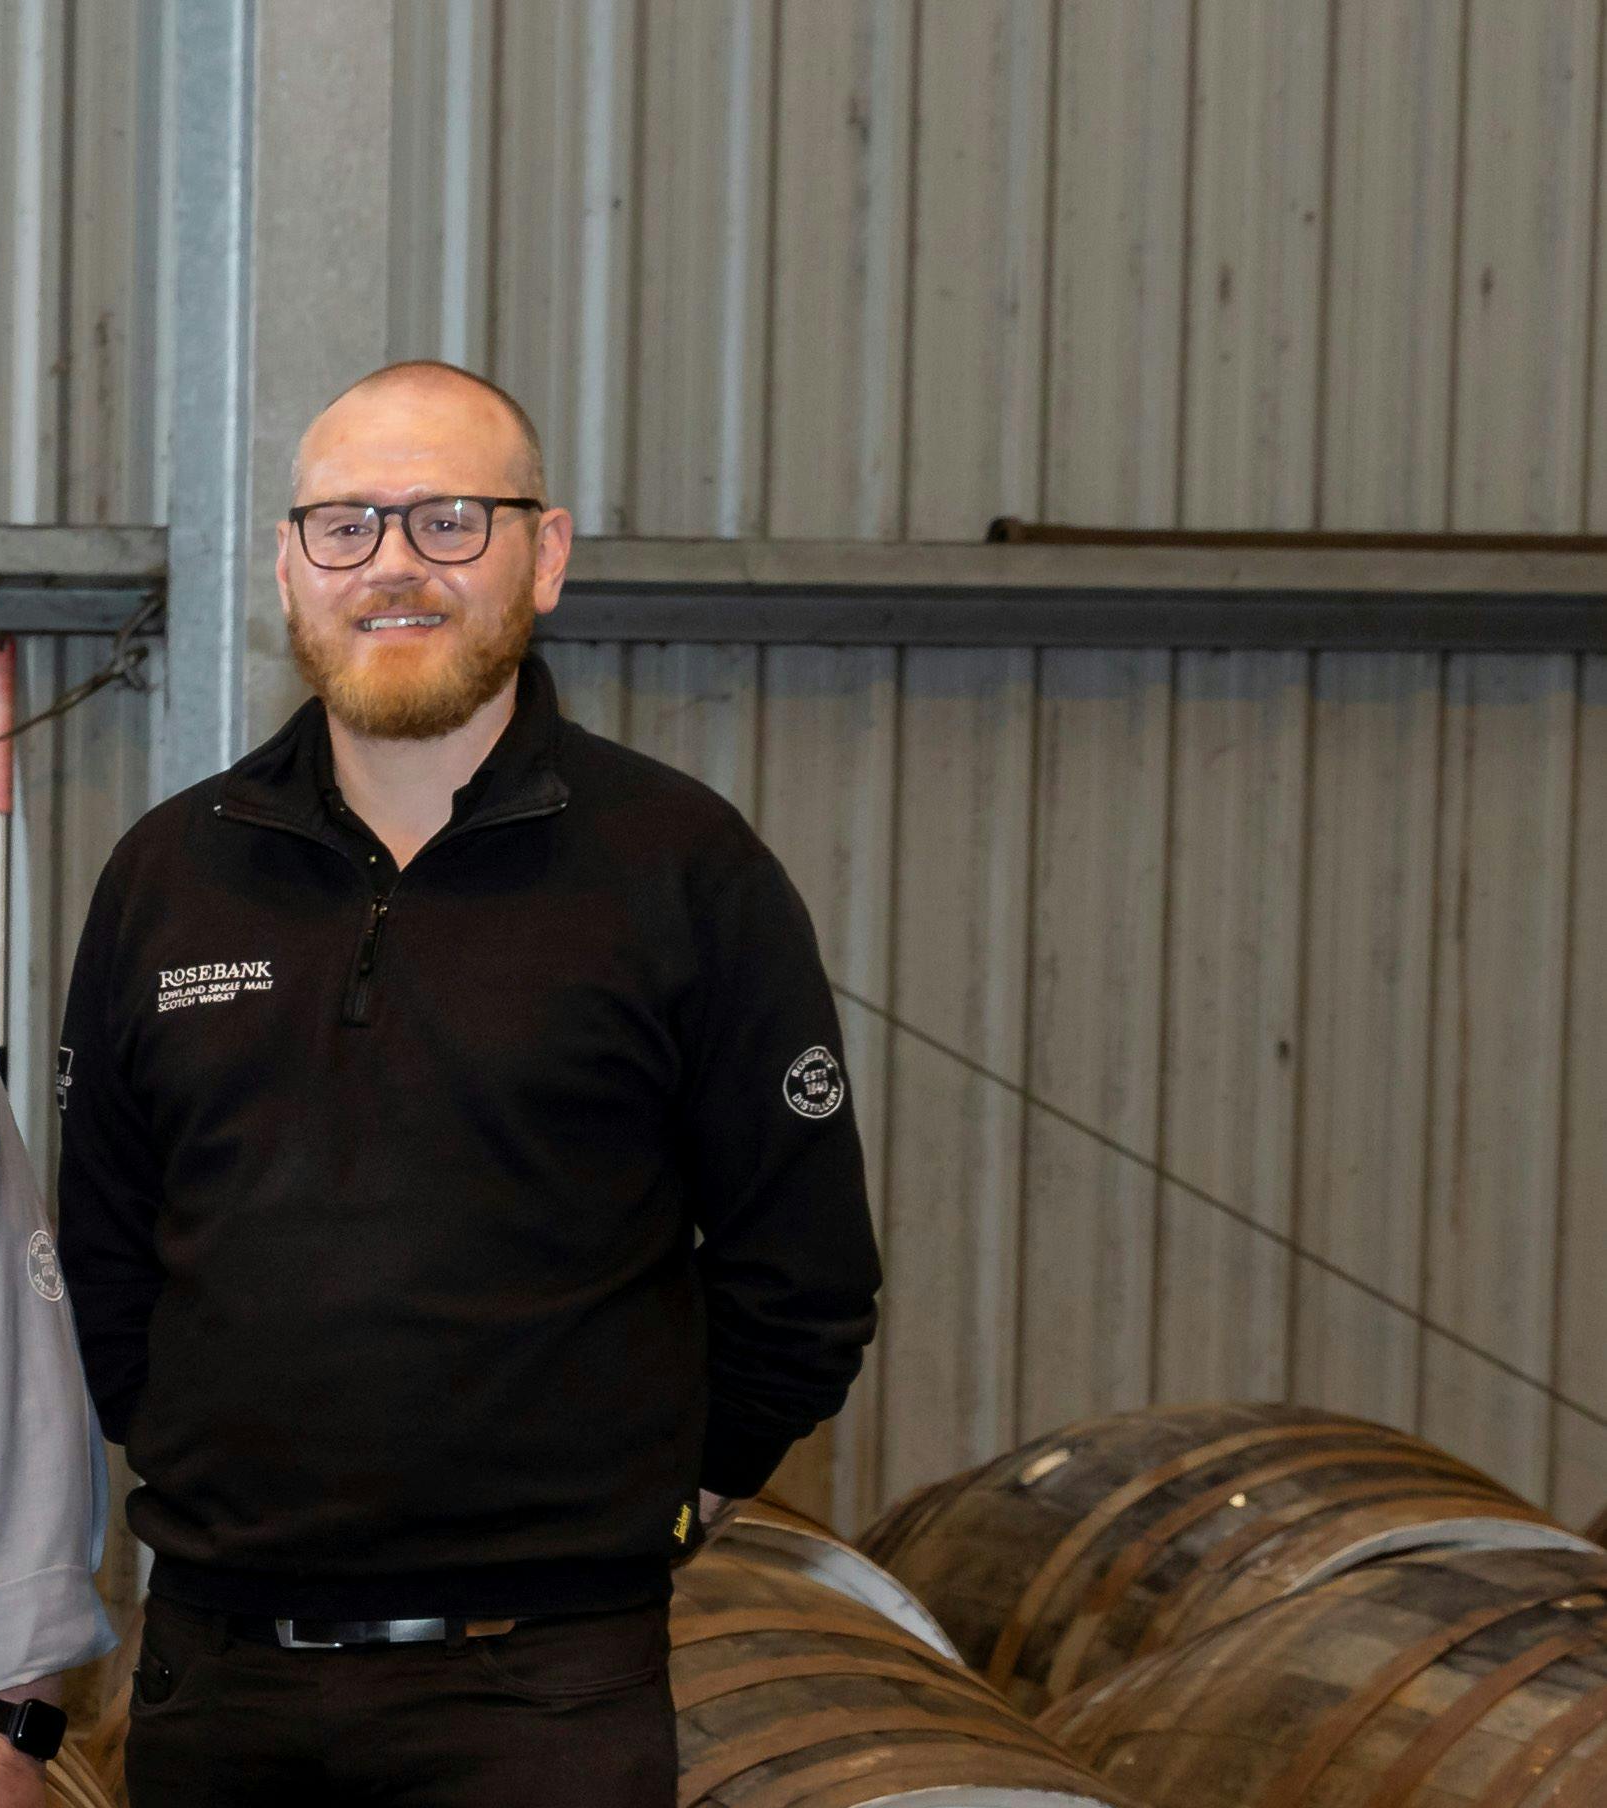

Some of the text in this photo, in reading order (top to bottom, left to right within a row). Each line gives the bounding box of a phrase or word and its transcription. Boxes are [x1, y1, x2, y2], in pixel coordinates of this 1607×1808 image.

[159, 961, 271, 988] ROSEBANK
[158, 981, 273, 1002] LOWLAND SINGLE MALT
[157, 992, 235, 1013] SCOTCH WHISKY
